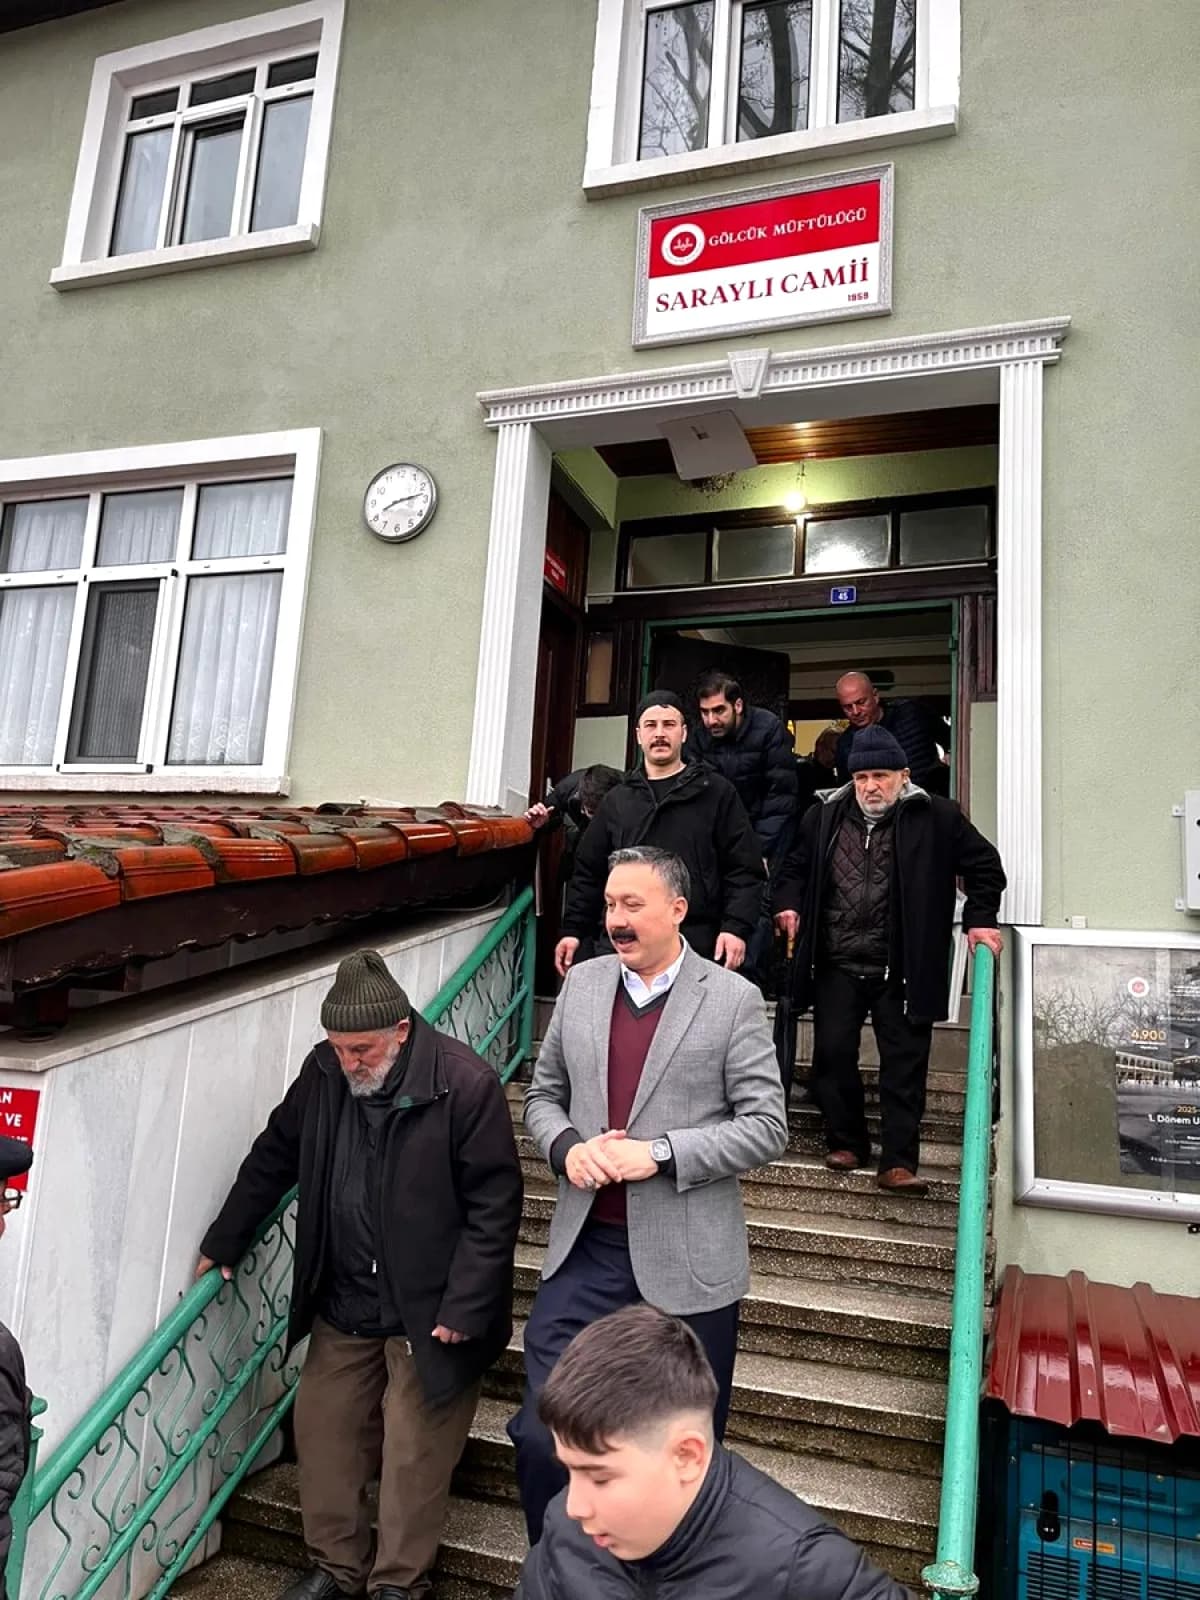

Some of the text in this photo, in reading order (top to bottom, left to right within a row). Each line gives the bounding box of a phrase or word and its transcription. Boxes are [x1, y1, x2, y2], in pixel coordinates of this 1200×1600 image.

[708, 226, 768, 247] GÖLCÜK
[655, 256, 870, 313] SARAYLI CAMİİ
[1131, 1029, 1167, 1041] 4.900
[0, 1091, 12, 1104] N
[5, 1111, 22, 1127] VE
[1156, 1114, 1191, 1125] Dönem
